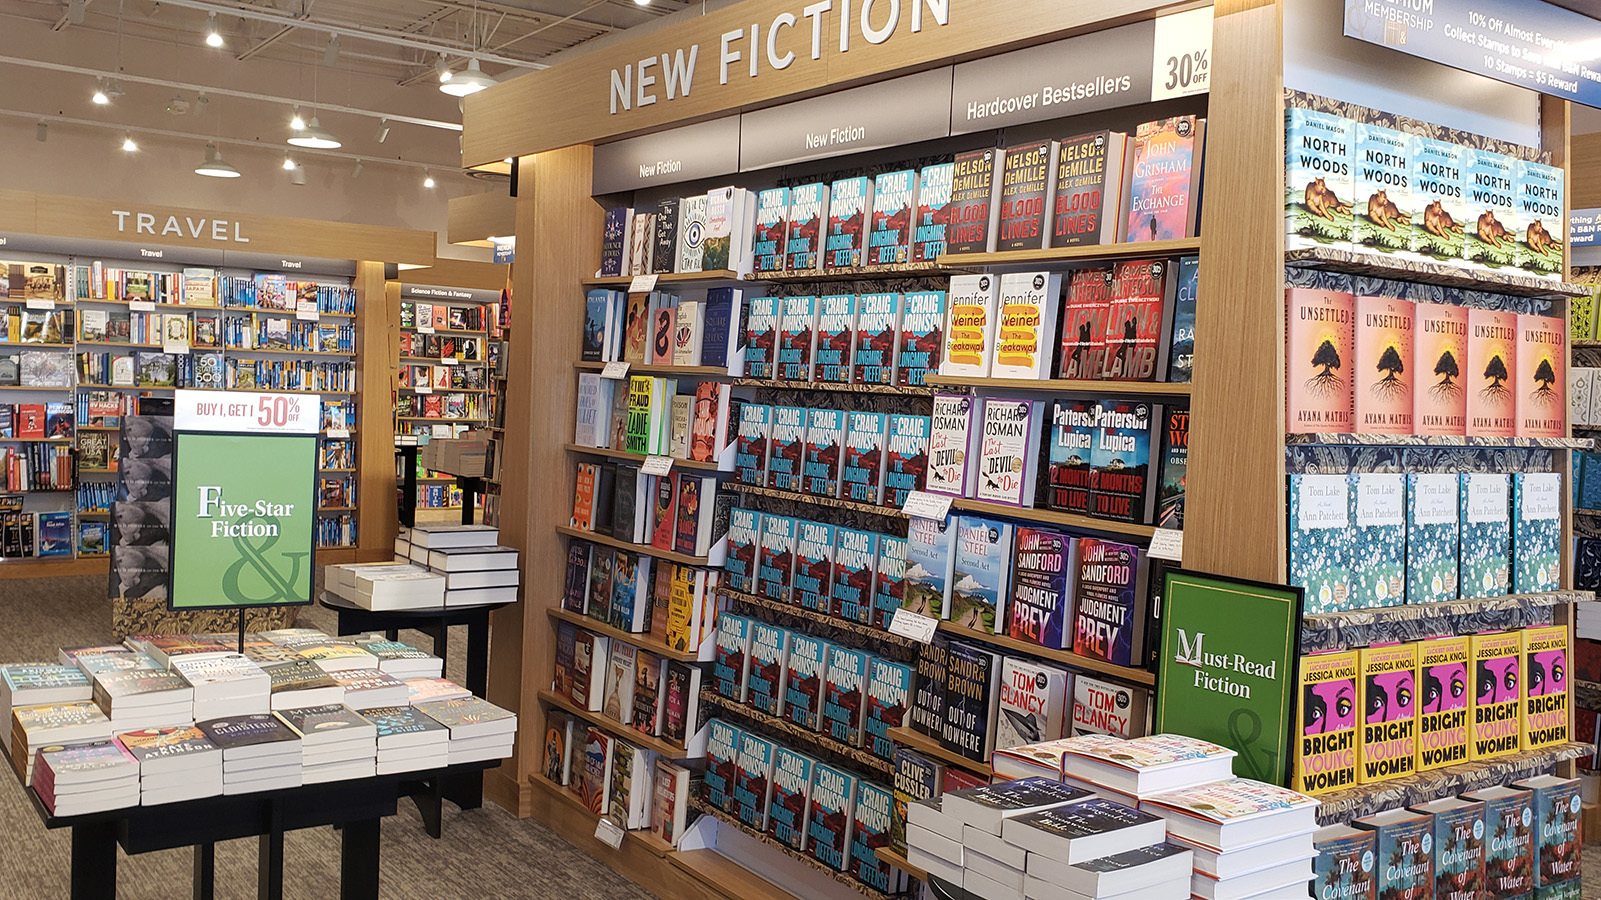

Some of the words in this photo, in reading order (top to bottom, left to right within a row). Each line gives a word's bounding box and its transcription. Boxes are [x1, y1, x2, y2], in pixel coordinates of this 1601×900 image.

[1364, 0, 1434, 32] MEMBERSHIP
[1468, 11, 1486, 28] 10%
[1488, 18, 1503, 32] Off
[1504, 23, 1534, 43] Almost
[610, 45, 699, 114] NEW
[719, 0, 949, 85] FICTION
[1444, 24, 1476, 45] Collect
[1478, 34, 1510, 56] Stamps
[1511, 45, 1521, 58] to
[1580, 66, 1601, 83] Rewa
[1165, 49, 1208, 91] 30%
[1192, 72, 1208, 84] OFF
[1484, 55, 1494, 69] 10
[1496, 59, 1527, 79] Stamps
[1536, 70, 1546, 85] $5
[1548, 74, 1578, 94] Reward
[967, 91, 1038, 120] Hardcover
[1042, 74, 1131, 106] Bestsellers
[1306, 120, 1324, 130] DANIEL
[1326, 126, 1344, 134] MASON
[806, 131, 827, 150] New
[830, 125, 865, 145] Fiction
[1303, 136, 1346, 156] NORTH
[1147, 140, 1176, 159] JOHN
[639, 165, 655, 178] New
[656, 159, 681, 175] Fiction
[1136, 160, 1187, 178] GRISHAM
[1300, 155, 1348, 176] WOODS
[1366, 150, 1406, 170] NORTH
[882, 172, 907, 193] CRAIG
[1058, 180, 1072, 190] ALEX
[1364, 168, 1408, 188] WOODS
[876, 188, 912, 211] JOHNSON
[1152, 184, 1163, 195] THE
[1525, 183, 1558, 200] NORTH
[664, 206, 672, 214] The
[1056, 191, 1100, 215] BLOOD
[1132, 194, 1184, 212] EXCHANGE
[1523, 200, 1559, 217] WOODS
[112, 210, 249, 243] TRAVEL
[658, 213, 667, 221] One
[878, 218, 887, 230] THE
[1056, 214, 1096, 236] LINES
[870, 230, 900, 247] LONGMIRE
[1577, 226, 1595, 234] B&N
[140, 248, 163, 258] Travel
[282, 260, 302, 268] Travel
[1111, 278, 1162, 297] PATTERSON
[1000, 290, 1044, 310] Jennifer
[1324, 296, 1332, 306] The
[1002, 312, 1039, 327] Weiner
[1106, 304, 1151, 336] LION
[1300, 306, 1350, 324] UNSETTLED
[996, 342, 1037, 354] Breakaway
[1102, 347, 1156, 378] LAMB
[634, 378, 645, 392] THE
[196, 402, 218, 416] BUY
[228, 404, 248, 417] GET
[258, 396, 300, 426] 50%
[630, 394, 650, 408] FRAUD
[628, 412, 648, 436] ZADIE
[1094, 404, 1147, 430] Patterson
[1298, 410, 1322, 422] AYANA
[1324, 411, 1348, 422] MATHIS
[986, 422, 1023, 437] OSMAN
[626, 436, 646, 452] SMITH
[984, 440, 1003, 456] Last
[1100, 428, 1136, 453] Lupica
[1003, 474, 1018, 492] Die
[1090, 470, 1099, 488] 12
[1100, 472, 1142, 493] MONTHS
[1308, 486, 1324, 497] Tom
[1325, 486, 1340, 497] Lake
[196, 486, 295, 518] Five-Star
[1096, 495, 1108, 513] TO
[1110, 497, 1130, 516] LIVE
[1302, 510, 1318, 521] Ann
[1319, 510, 1344, 521] Patchett
[210, 520, 278, 538] Fiction
[964, 542, 988, 556] STEEL
[1084, 544, 1104, 562] JOHN
[960, 558, 978, 568] Second
[980, 562, 990, 570] Act
[1082, 564, 1130, 585] SANDFORD
[1080, 598, 1126, 626] JUDGMENT
[1078, 614, 1118, 660] PREY
[1174, 628, 1276, 680] Must-Read
[949, 656, 985, 682] SANDRA
[1304, 671, 1334, 682] JESSICA
[1336, 667, 1356, 678] KNOLL
[948, 674, 983, 701] BROWN
[1012, 670, 1036, 690] TOM
[1193, 670, 1250, 700] Fiction
[1001, 686, 1046, 715] CLANCY
[948, 706, 963, 724] OUT
[965, 710, 976, 729] OF
[214, 722, 278, 736] CLOISTERS
[943, 722, 980, 753] NOWHERE
[1303, 731, 1354, 756] BRIGHT
[902, 759, 924, 782] CLIVE
[1302, 749, 1354, 774] YOUNG
[820, 769, 844, 795] CRAIG
[894, 772, 930, 799] CUSSLER
[1303, 767, 1354, 792] WOMEN
[812, 784, 848, 816] JOHNSON
[1555, 800, 1568, 814] The
[1068, 814, 1088, 825] The
[1544, 819, 1578, 838] Covenant
[1558, 838, 1566, 856] of
[860, 862, 888, 892] DEFENSE
[1552, 860, 1573, 875] Water
